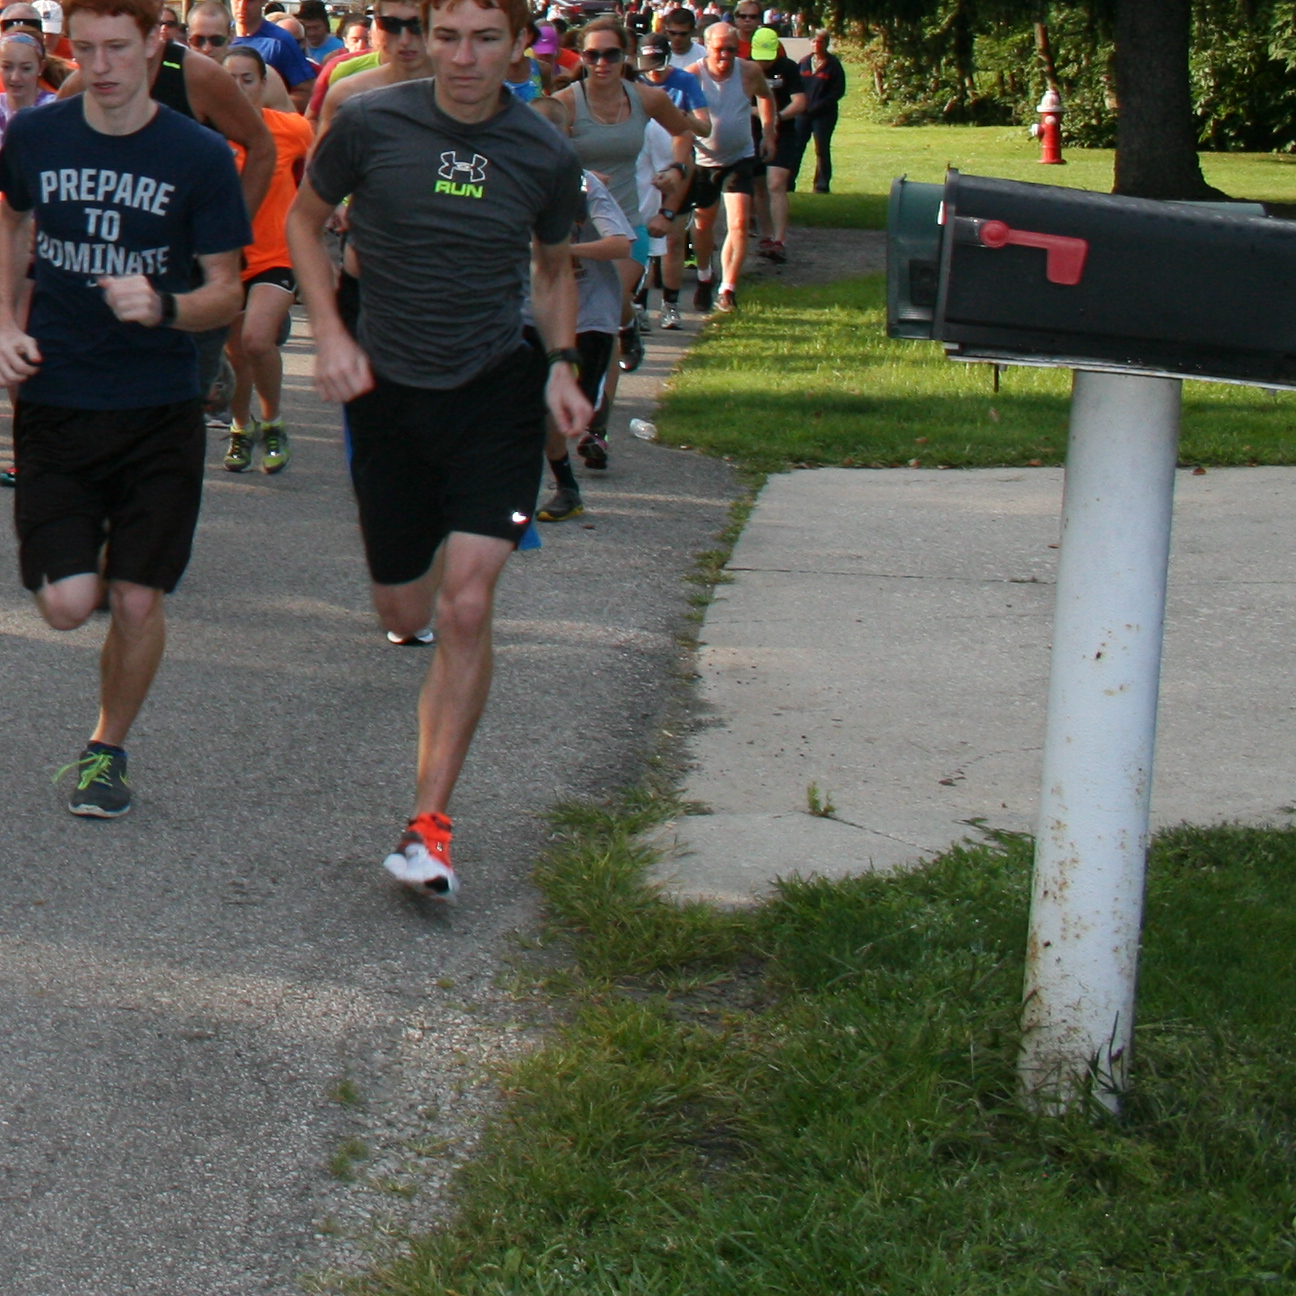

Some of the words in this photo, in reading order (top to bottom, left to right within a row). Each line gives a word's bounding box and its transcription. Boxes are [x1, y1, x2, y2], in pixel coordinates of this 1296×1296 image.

[40, 167, 175, 216] PREPARE
[434, 179, 483, 198] RUN
[84, 207, 121, 242] TO
